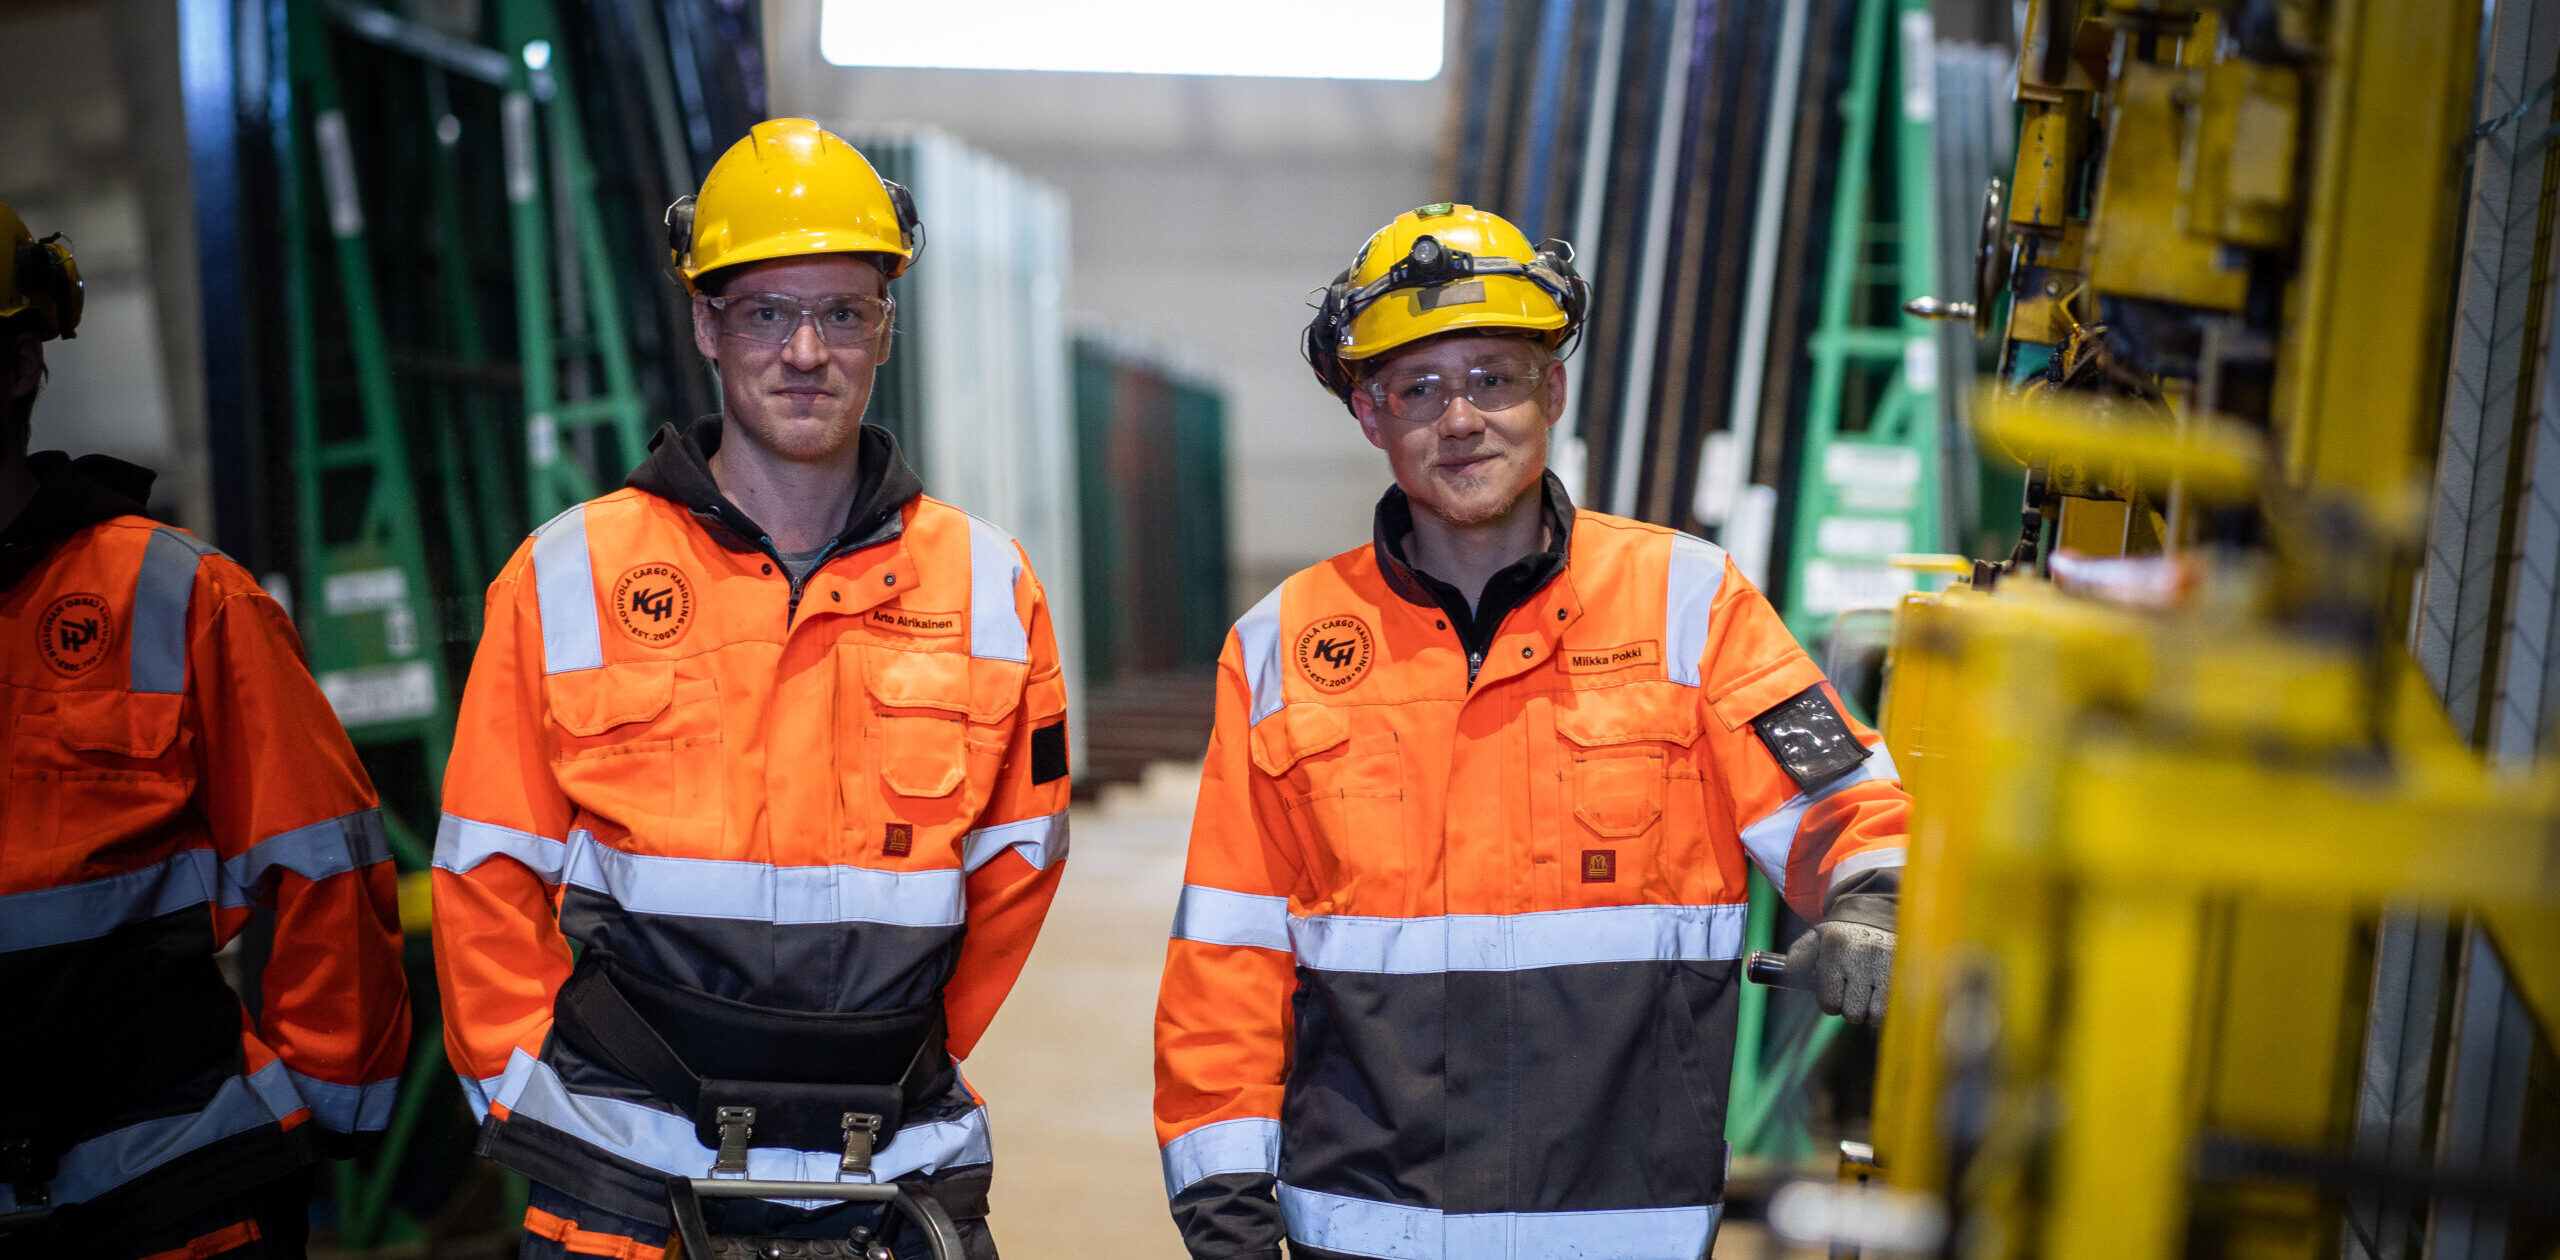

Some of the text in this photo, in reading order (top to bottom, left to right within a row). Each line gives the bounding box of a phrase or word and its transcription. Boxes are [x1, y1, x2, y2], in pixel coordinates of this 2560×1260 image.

[617, 567, 689, 625] KOUVOLA CARGO HANDLING
[873, 610, 953, 629] Arto Airikainen
[1299, 619, 1370, 673] KOUVOLA CARGO HANDLING
[1572, 648, 1642, 667] Miikka Pokki
